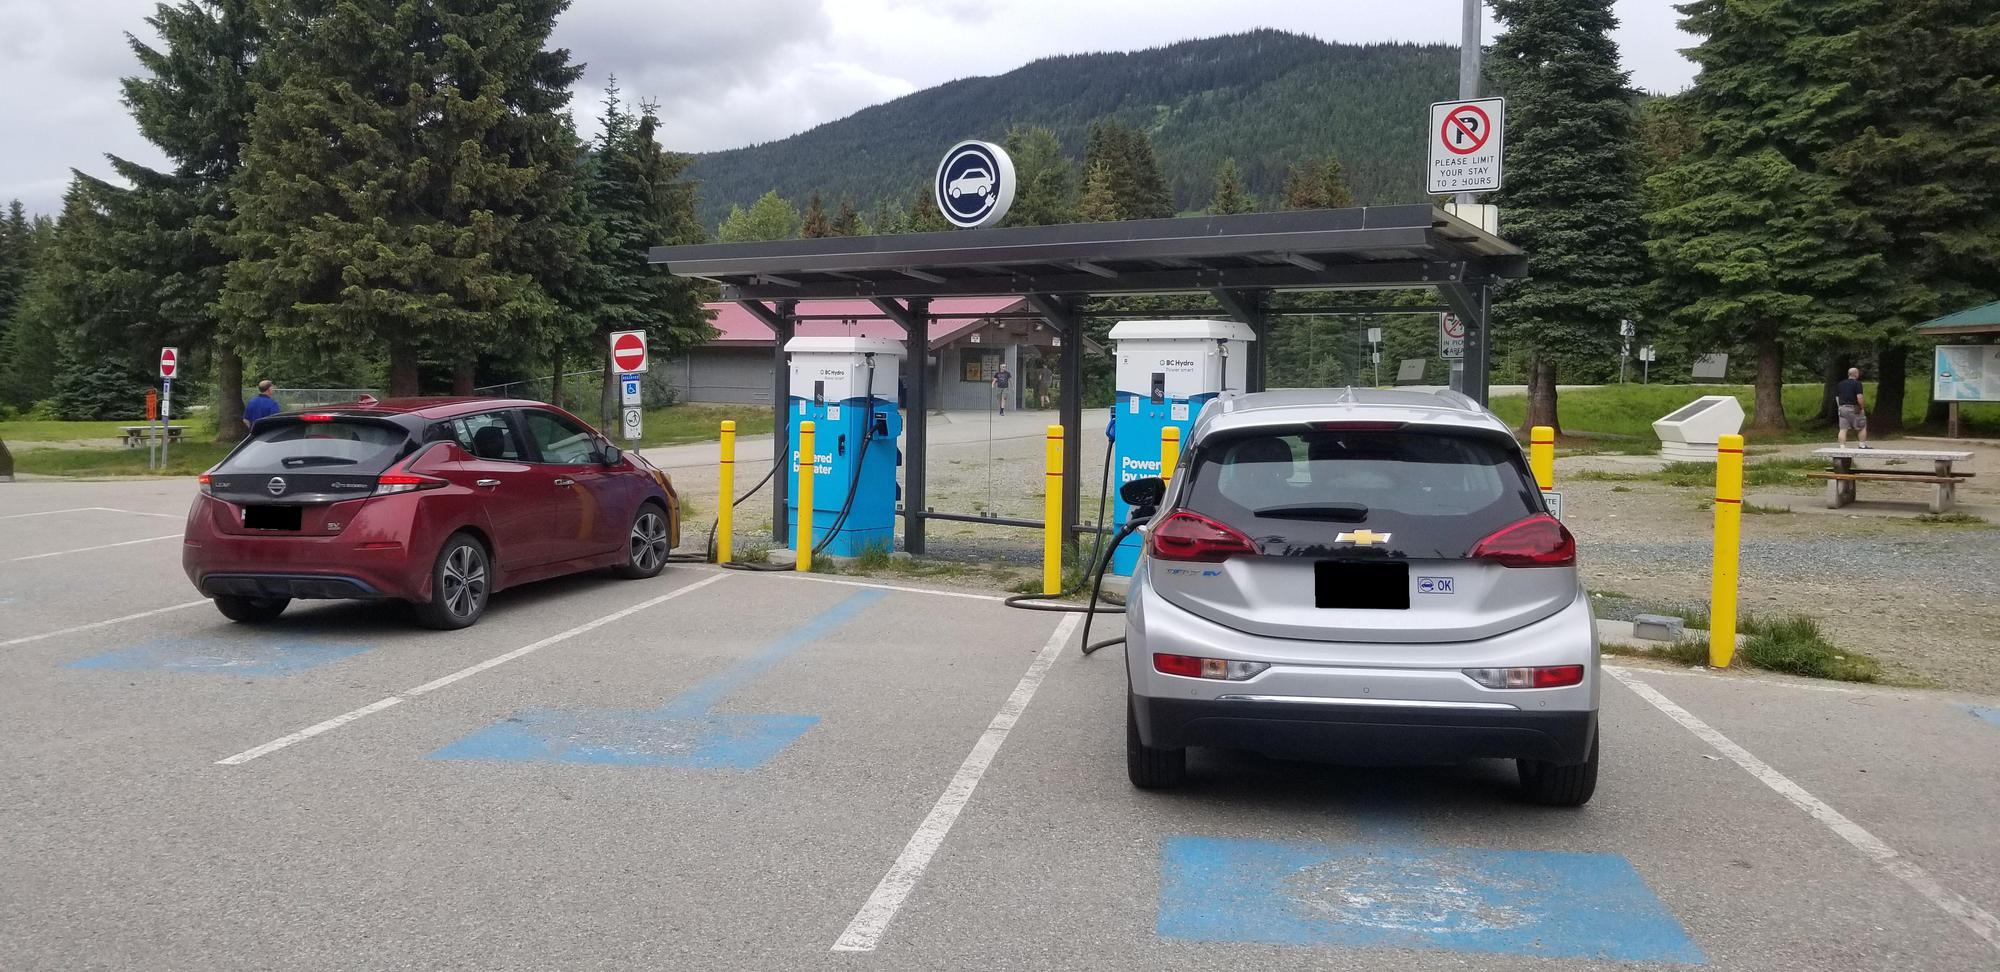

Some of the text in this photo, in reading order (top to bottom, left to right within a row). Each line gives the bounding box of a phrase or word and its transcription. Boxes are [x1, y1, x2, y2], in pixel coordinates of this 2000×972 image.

[1435, 156, 1494, 166] PLEASE LIMIT
[1440, 167, 1488, 177] YOUR STAY
[1437, 176, 1492, 188] TO 2 HOURS
[1175, 359, 1194, 367] Hydro
[793, 450, 832, 464] Pered
[1122, 456, 1162, 470] Power
[813, 464, 832, 475] ater
[1437, 580, 1452, 591] OK
